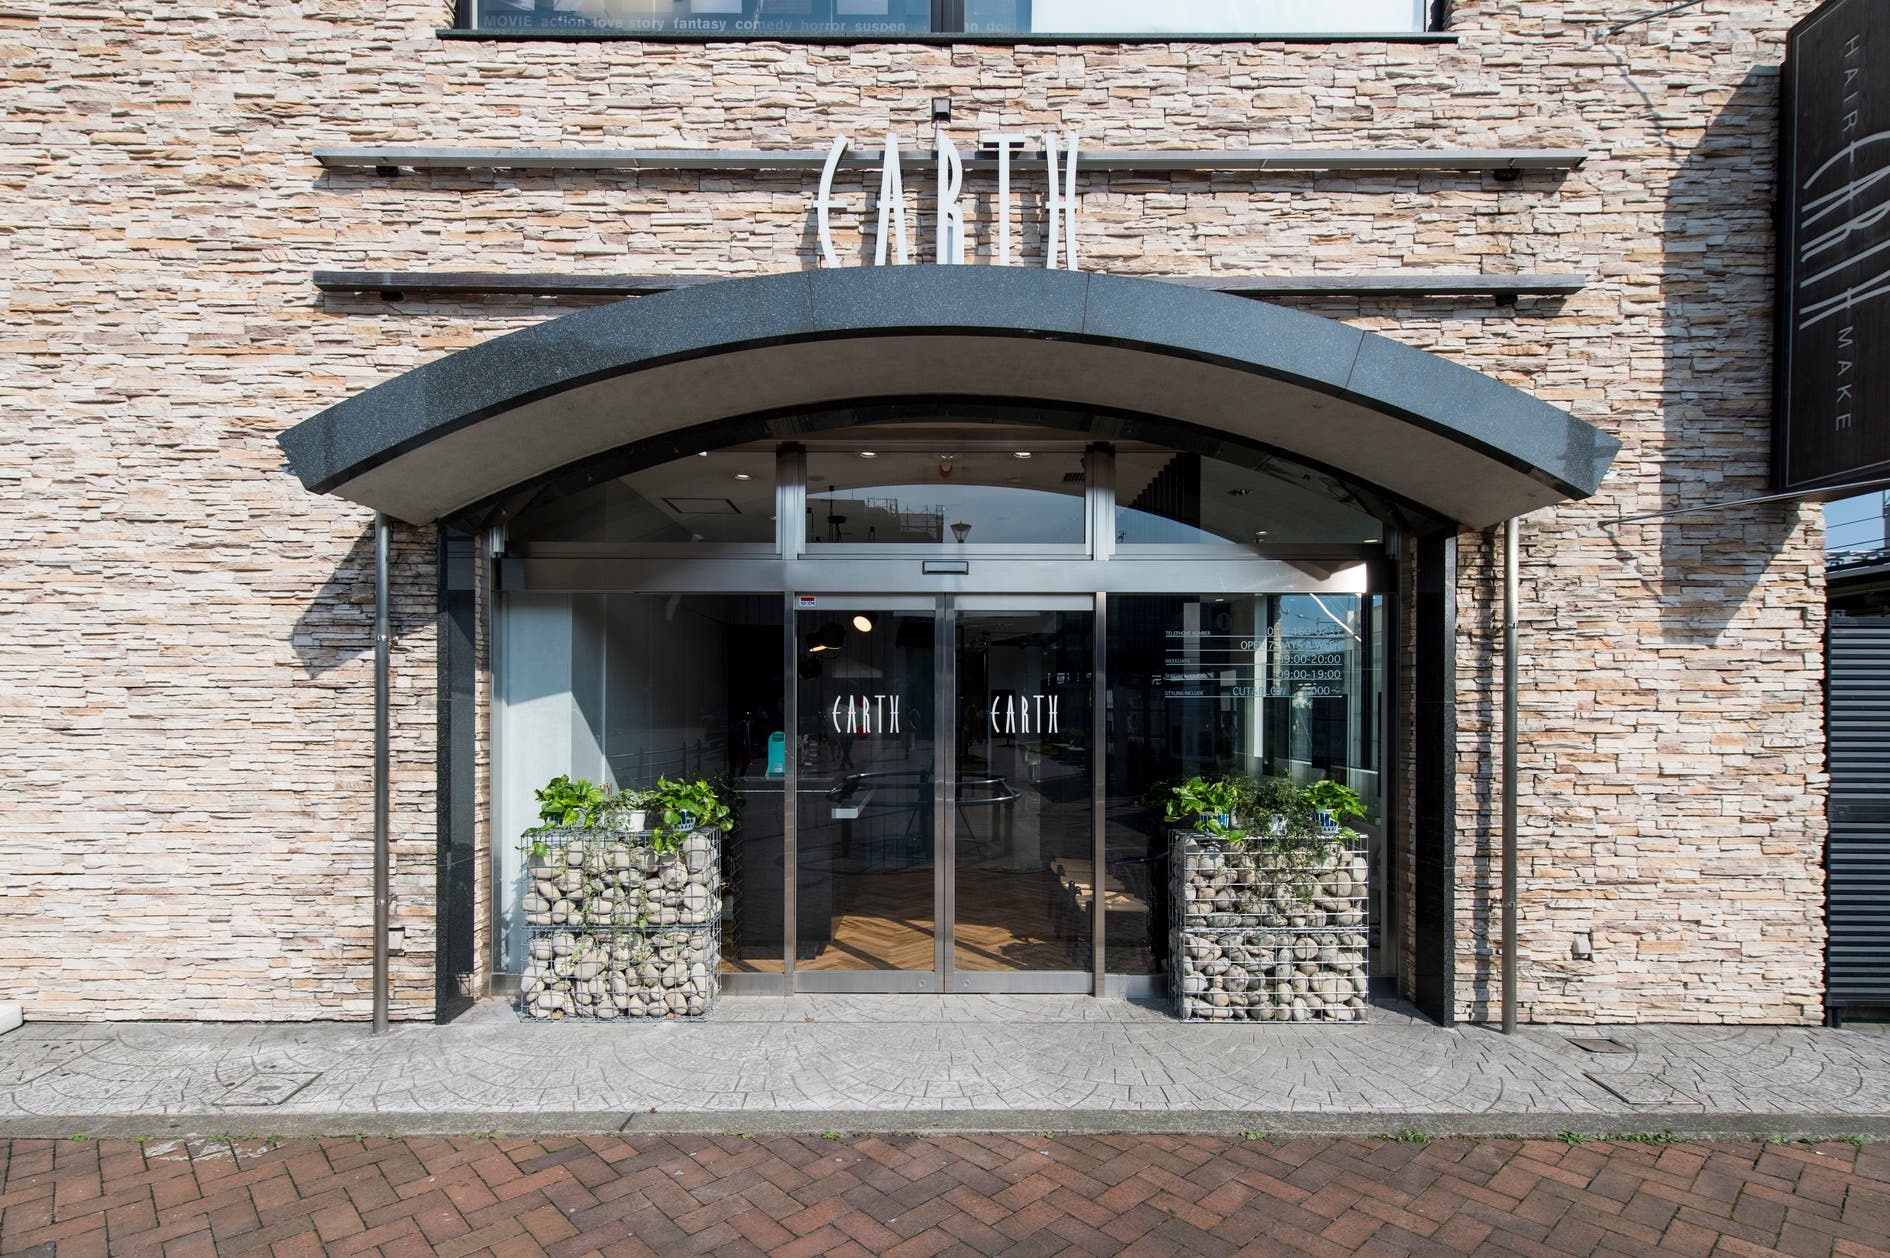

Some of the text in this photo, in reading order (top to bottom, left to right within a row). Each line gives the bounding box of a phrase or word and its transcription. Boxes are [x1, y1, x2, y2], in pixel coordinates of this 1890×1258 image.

[483, 15, 533, 28] MOVIE
[541, 15, 586, 28] action
[593, 15, 623, 28] love
[629, 16, 665, 31] story
[673, 17, 727, 32] fantasy
[801, 18, 846, 31] horror
[855, 20, 914, 33] suspen
[1842, 33, 1860, 133] HAIR
[813, 130, 1080, 270] EARTH
[1836, 326, 1854, 431] MAKE
[1268, 640, 1275, 650] 7
[1278, 654, 1341, 664] 09:00-20:00
[1277, 669, 1341, 679] 09:00-19:00
[832, 694, 900, 734] EARTH
[991, 694, 1059, 734] EARTH
